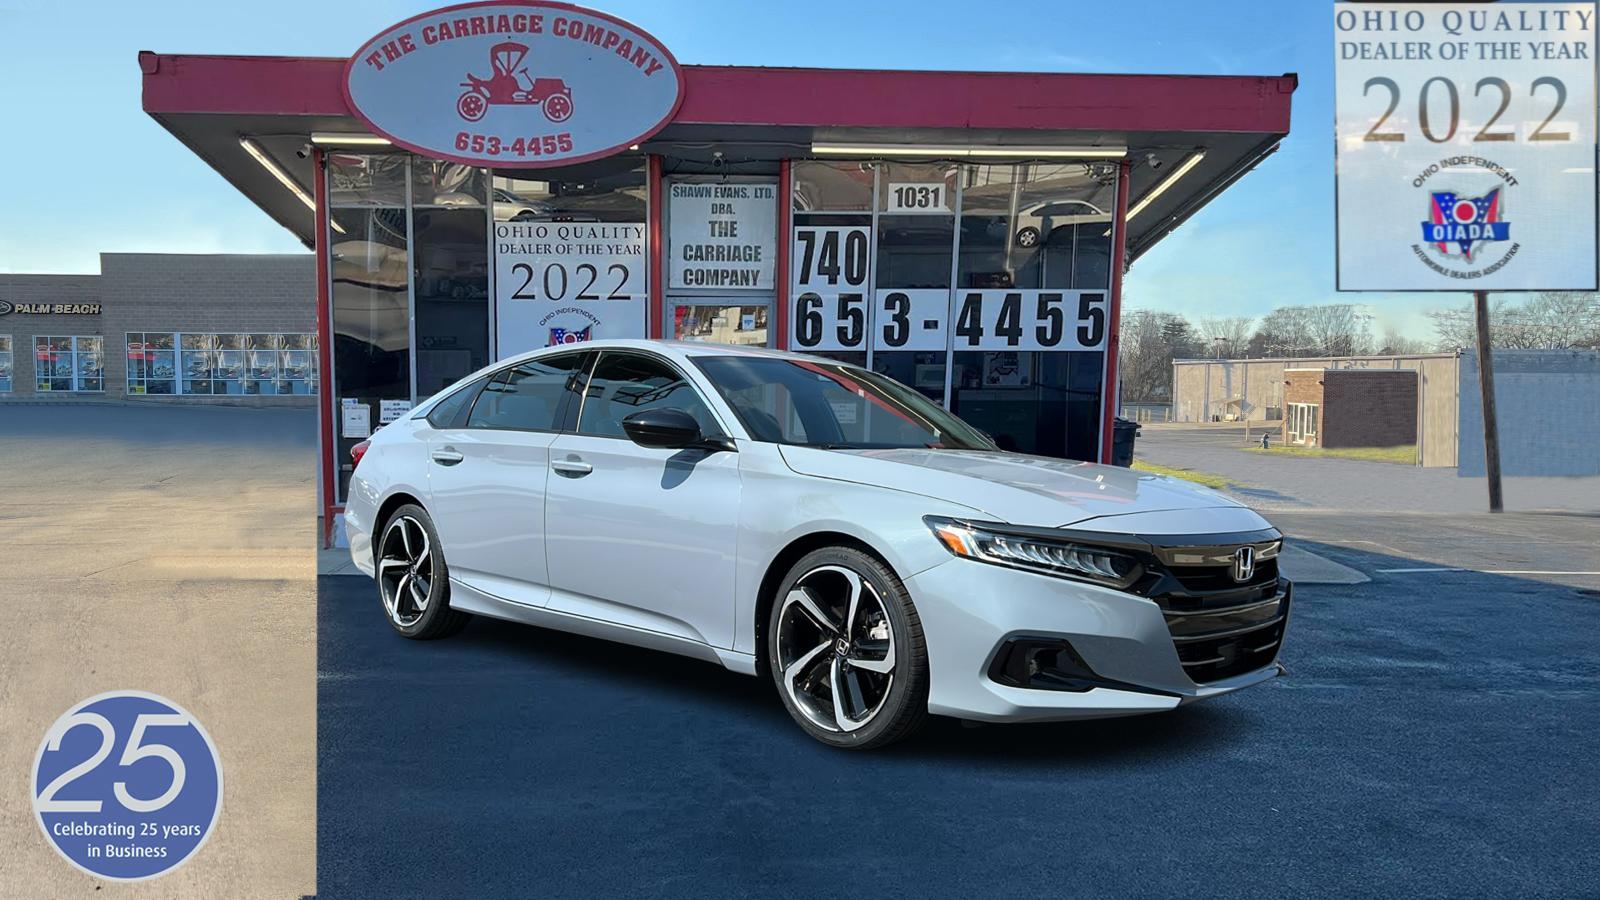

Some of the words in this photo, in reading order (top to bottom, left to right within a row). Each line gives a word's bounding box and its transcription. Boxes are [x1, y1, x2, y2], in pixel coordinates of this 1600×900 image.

[1336, 10, 1425, 31] OHIO
[1442, 10, 1593, 35] QUALITY
[365, 34, 417, 71] THE
[422, 14, 544, 46] CARRIAGE
[552, 17, 664, 77] COMPANY
[1340, 42, 1432, 60] DEALER
[1439, 42, 1469, 60] OF
[1475, 42, 1522, 60] THE
[1528, 42, 1589, 60] YEAR
[1363, 76, 1571, 143] 2022
[455, 132, 574, 156] 653-4455
[1413, 163, 1440, 188] OHIO
[1440, 155, 1519, 188] INDEPENDENT
[673, 186, 712, 199] SHAWN
[714, 186, 750, 199] EVANS.
[755, 187, 775, 199] LTD.
[894, 187, 940, 208] 1031
[711, 203, 736, 215] DBA.
[497, 226, 552, 239] OHIO
[558, 225, 644, 240] QUALITY
[709, 221, 738, 237] THE
[1432, 224, 1495, 240] OIADA
[500, 243, 552, 255] DEALER
[555, 243, 575, 255] OF
[576, 243, 603, 255] THE
[606, 243, 641, 255] YEAR
[683, 244, 762, 262] CARRIAGE
[797, 230, 867, 285] 740
[511, 263, 632, 300] 2022
[683, 268, 760, 286] COMPANY
[1450, 270, 1482, 280] DEALERS
[15, 304, 51, 314] PALM
[54, 304, 100, 314] BEACH
[555, 306, 601, 326] INDEPENDENT
